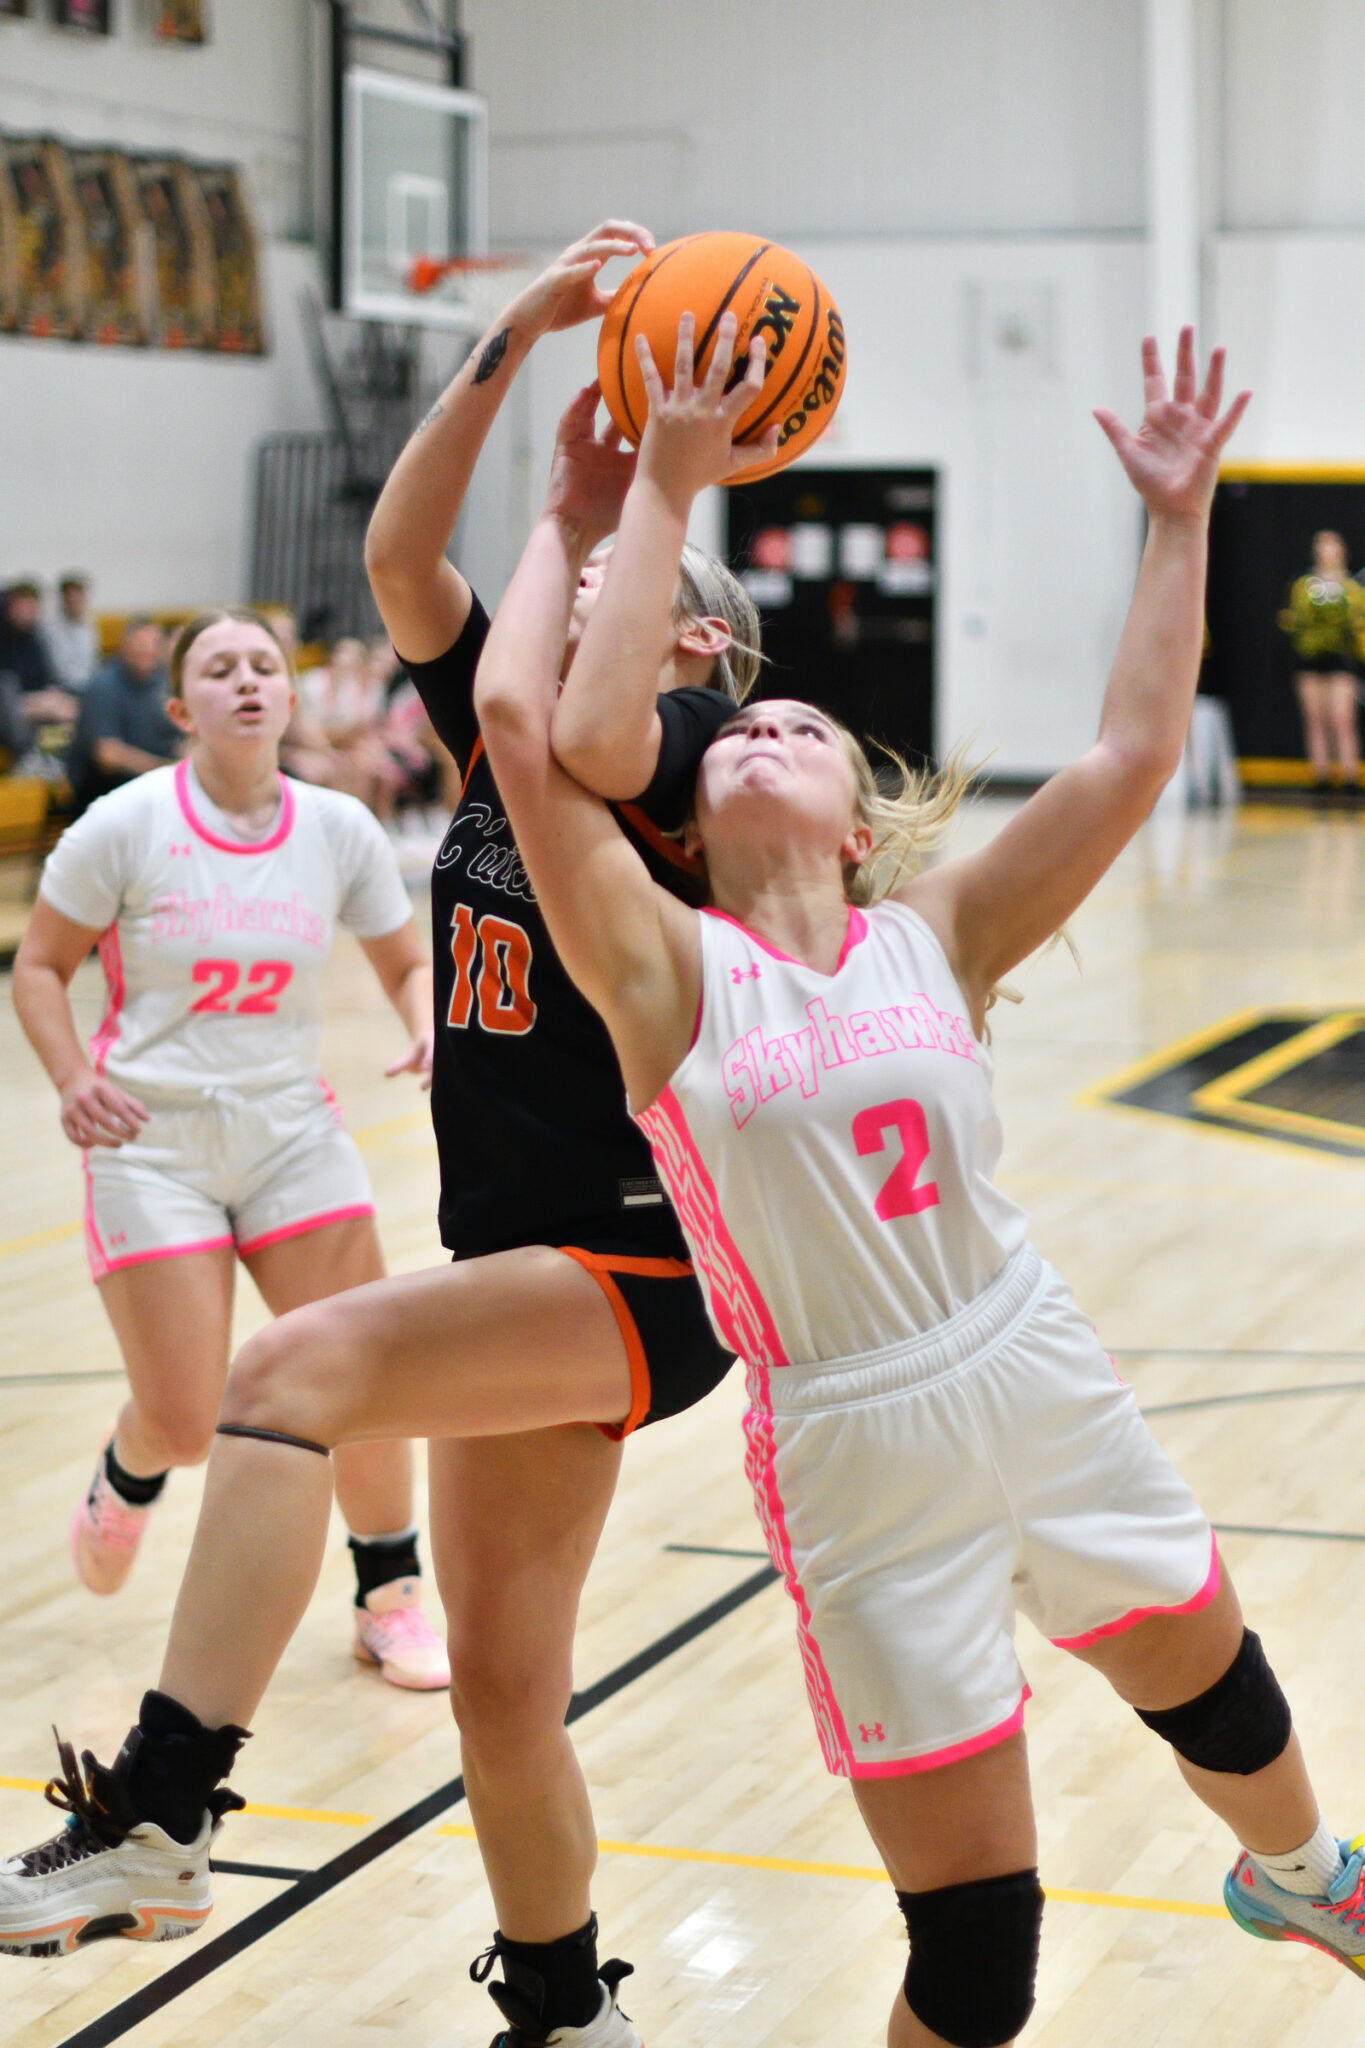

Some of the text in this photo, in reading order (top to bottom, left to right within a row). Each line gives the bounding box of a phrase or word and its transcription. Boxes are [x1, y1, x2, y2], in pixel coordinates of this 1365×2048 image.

[189, 958, 294, 1014] 22
[447, 902, 537, 1035] 10
[851, 1097, 940, 1222] 2
